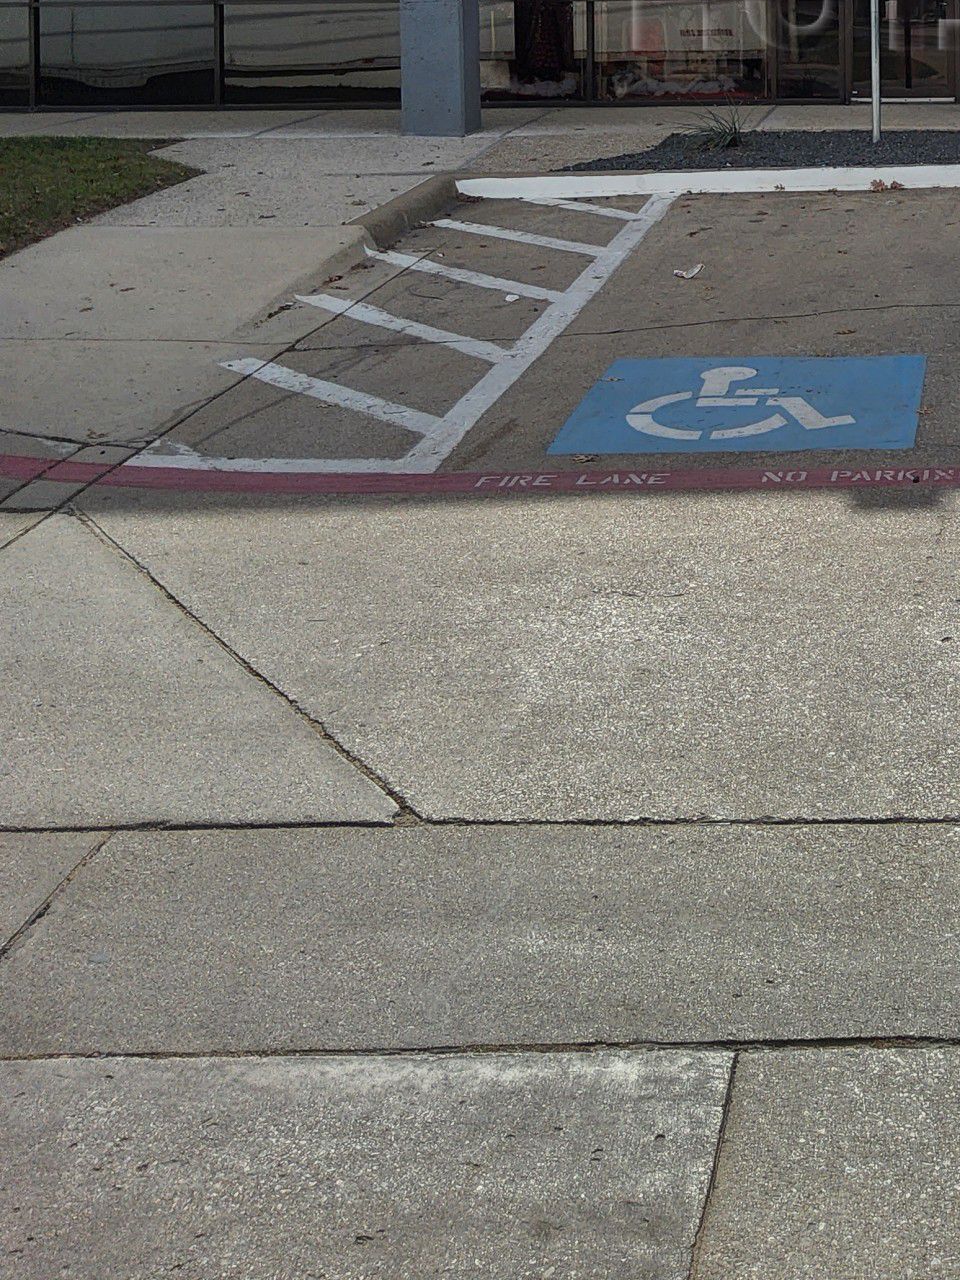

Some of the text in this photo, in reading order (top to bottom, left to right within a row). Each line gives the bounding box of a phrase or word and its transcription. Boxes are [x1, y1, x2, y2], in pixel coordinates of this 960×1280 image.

[474, 475, 558, 488] FIRE
[576, 473, 671, 485] LANE
[762, 471, 807, 483] NO
